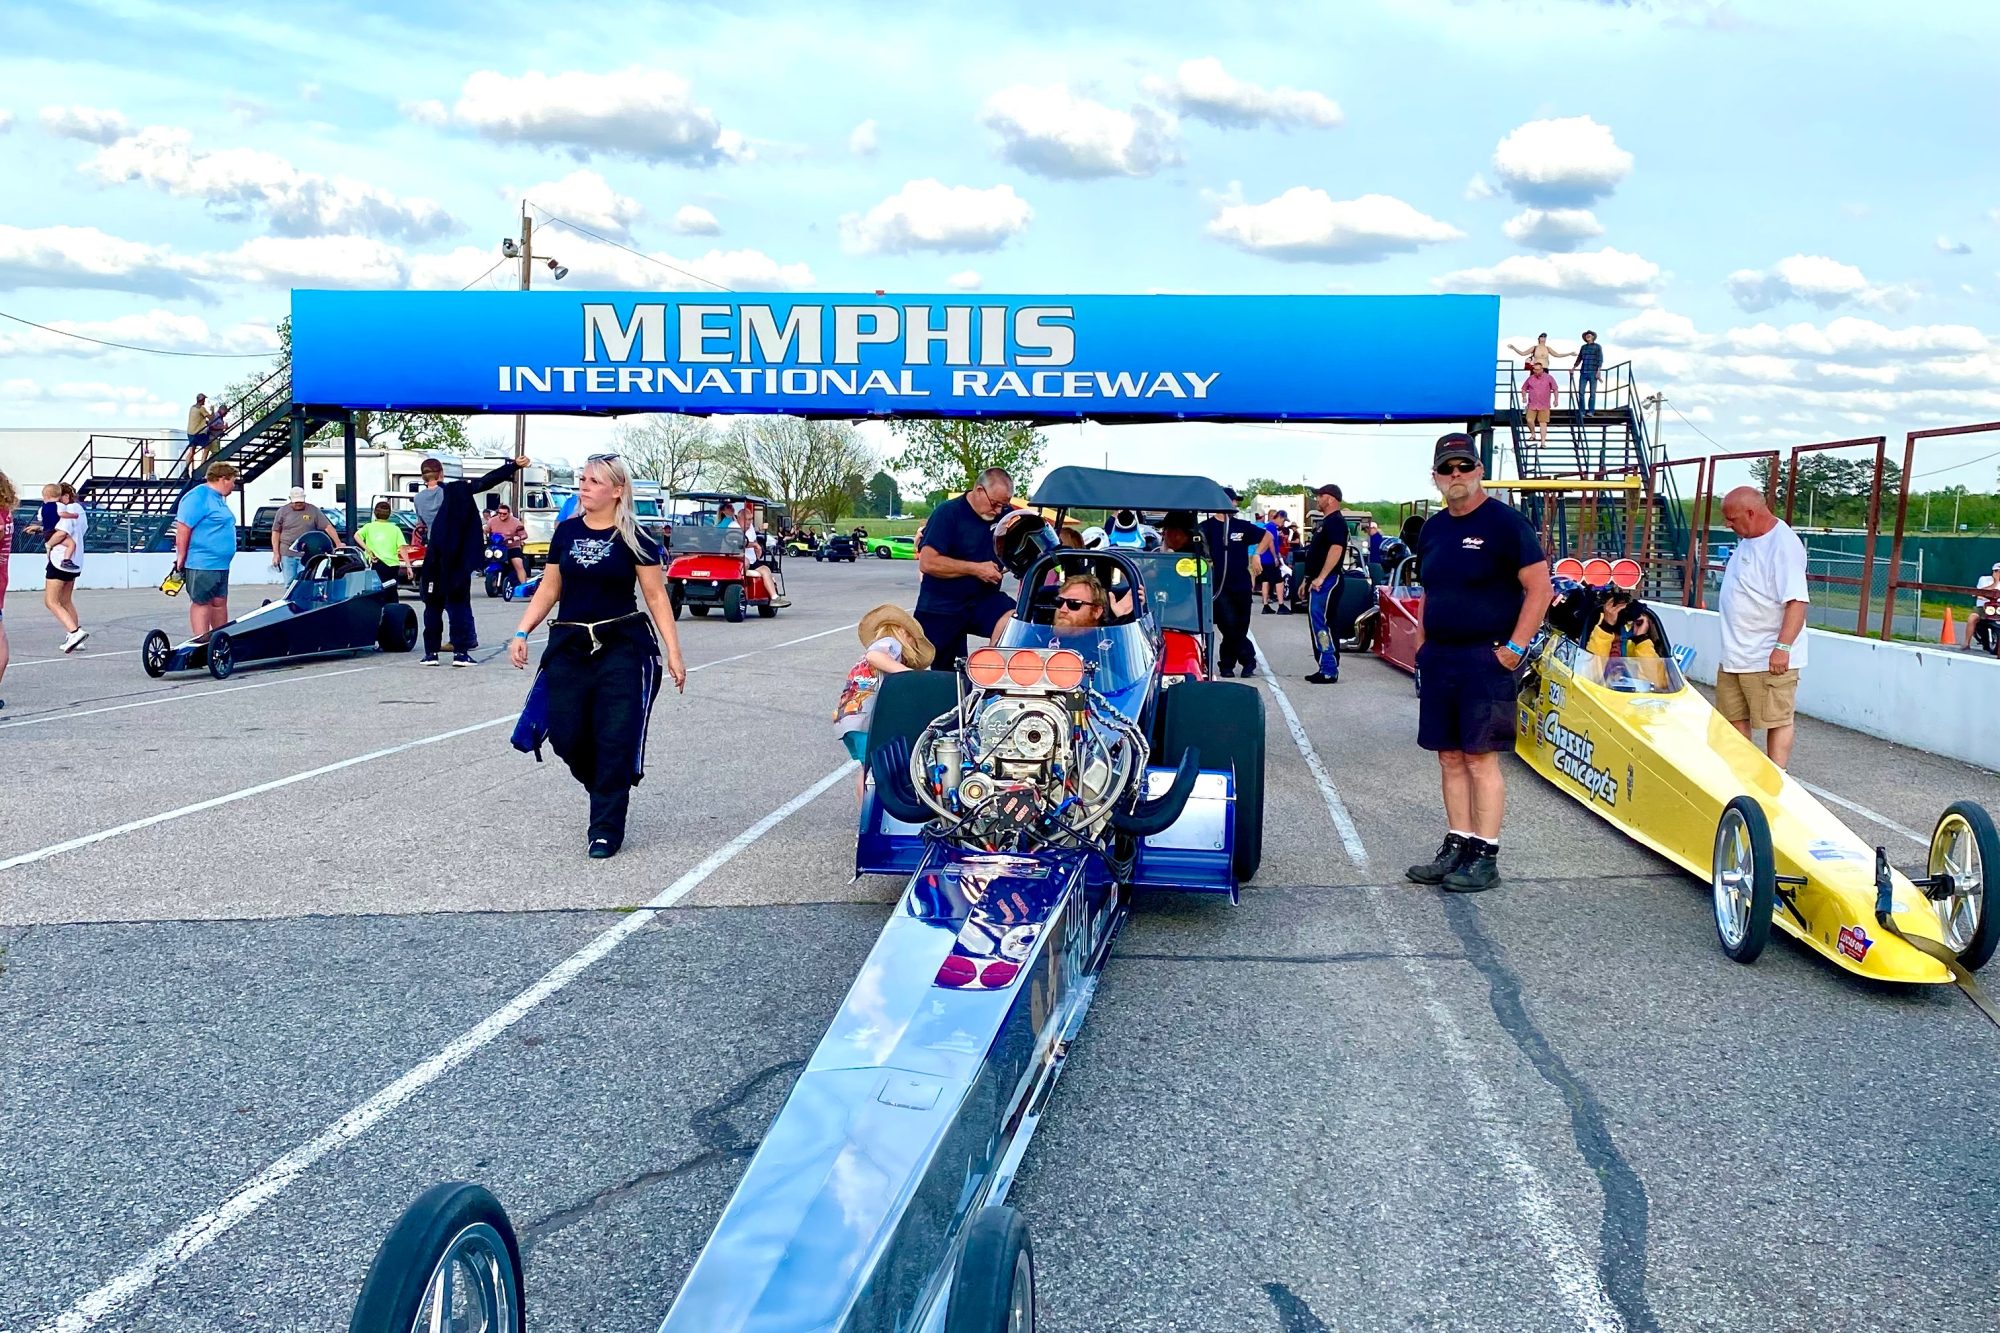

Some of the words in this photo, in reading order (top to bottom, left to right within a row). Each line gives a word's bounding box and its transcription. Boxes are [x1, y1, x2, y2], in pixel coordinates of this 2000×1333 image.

[582, 303, 1076, 368] MEMPHIS
[499, 366, 930, 397] INTERNATIONAL
[952, 370, 1221, 400] RACEWAY
[1543, 709, 1595, 766] Chassis
[1553, 748, 1618, 807] Concepts
[1840, 932, 1856, 948] LUCAS
